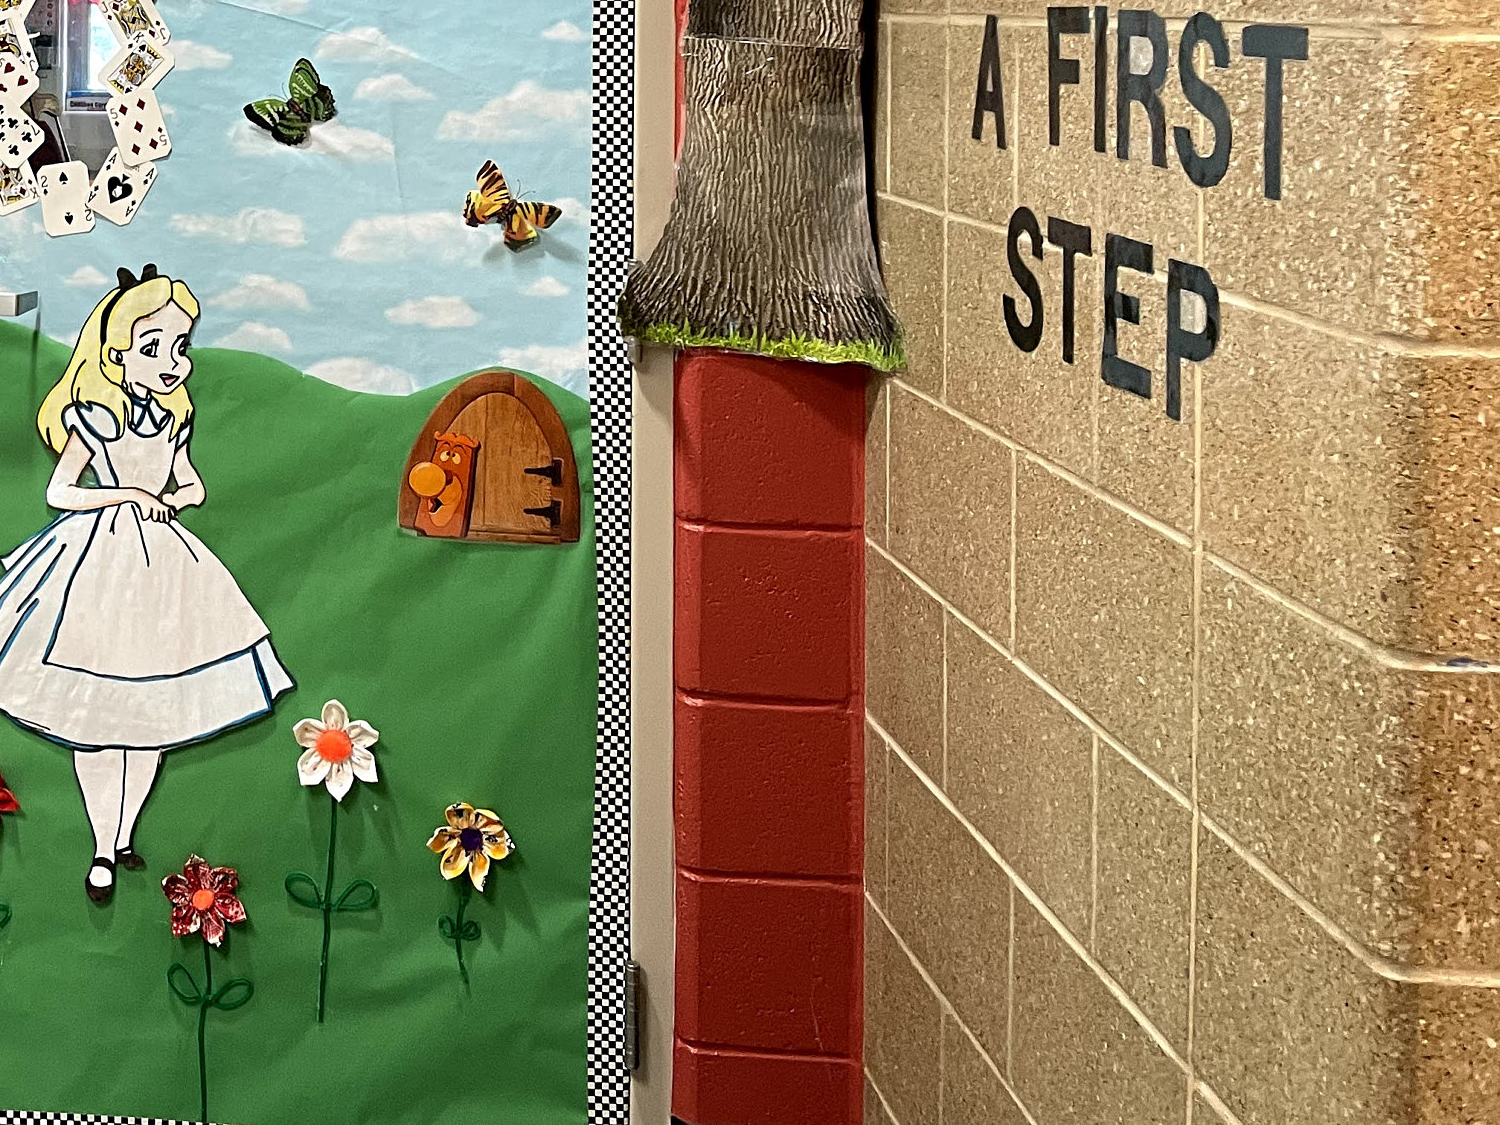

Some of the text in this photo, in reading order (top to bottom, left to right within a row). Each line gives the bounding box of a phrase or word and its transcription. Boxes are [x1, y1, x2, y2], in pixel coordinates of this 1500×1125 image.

[971, 5, 1309, 201] A FIRST
[1002, 206, 1222, 422] STEP
